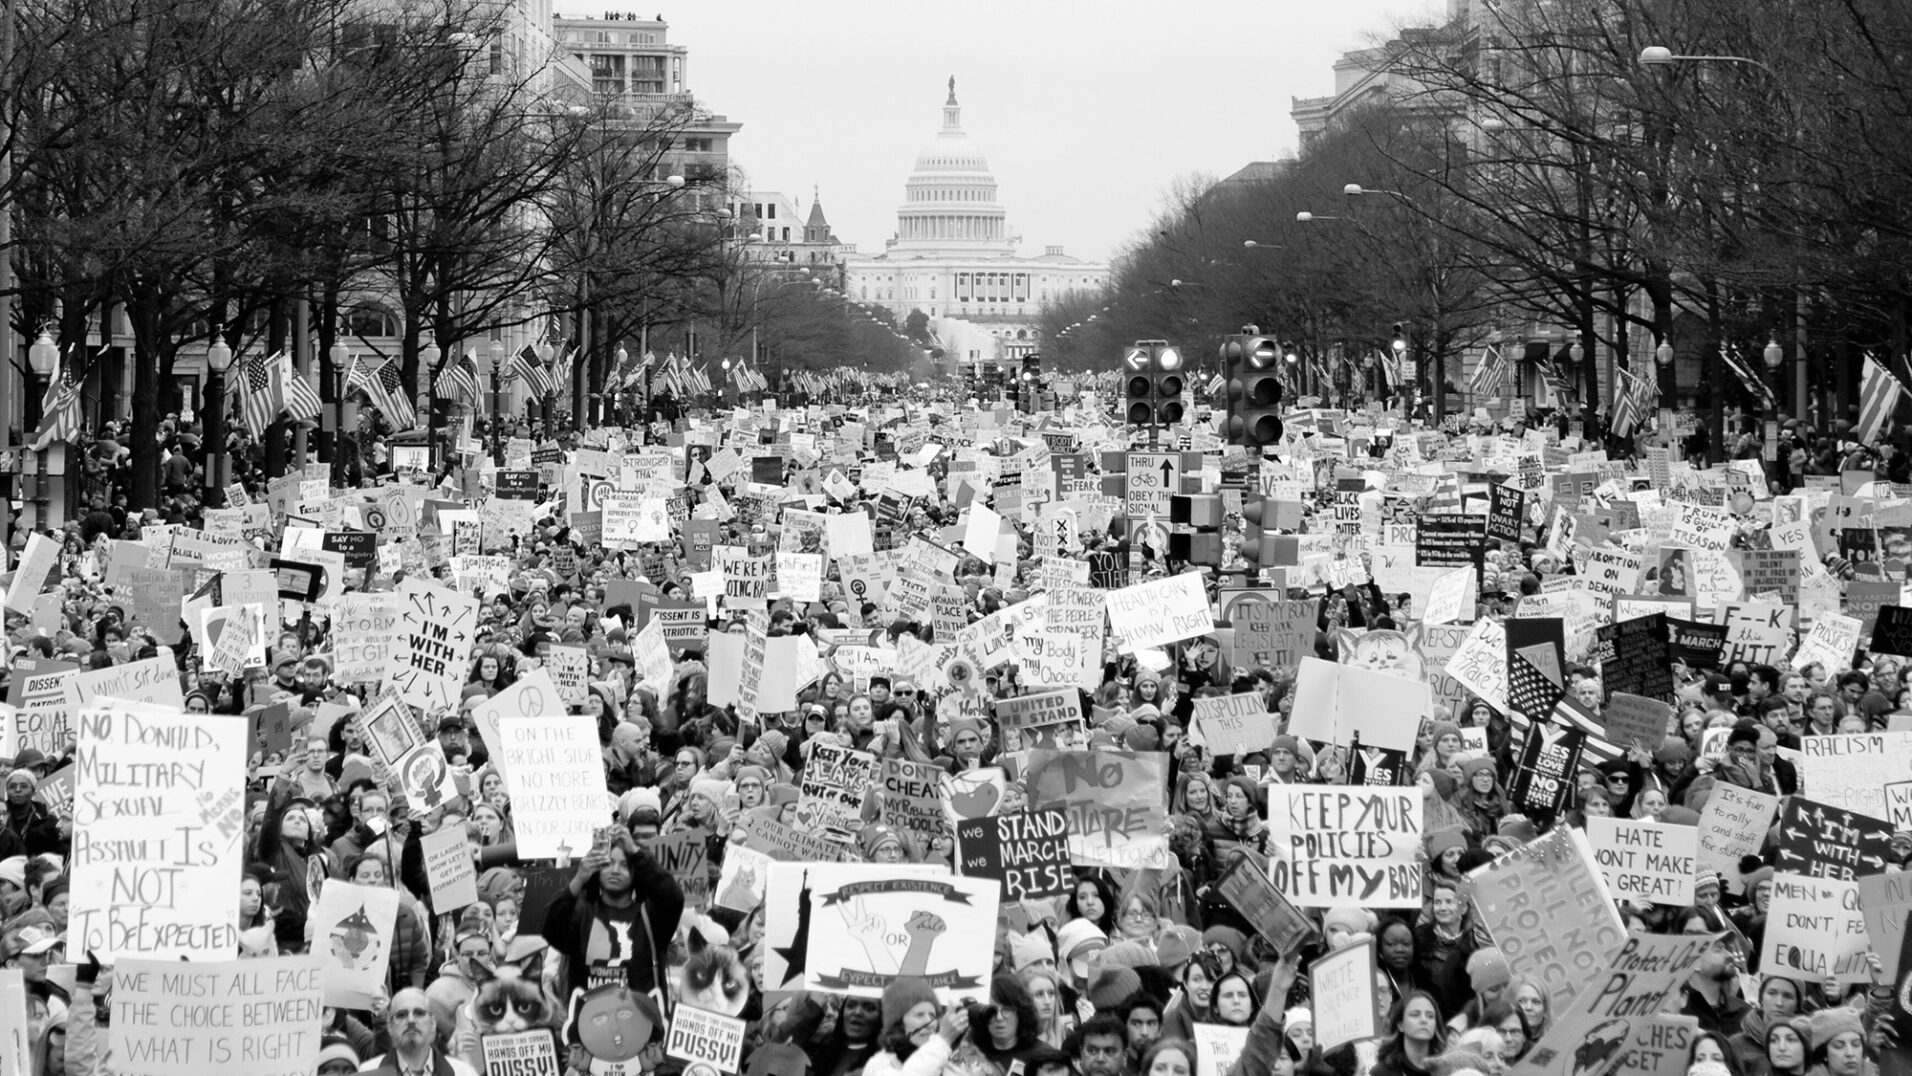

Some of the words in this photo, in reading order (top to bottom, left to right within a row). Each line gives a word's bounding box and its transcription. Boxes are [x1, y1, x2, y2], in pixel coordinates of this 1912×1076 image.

[623, 458, 669, 467] STRONGER
[1131, 457, 1154, 467] THRU
[1130, 491, 1153, 500] OBEY
[1157, 491, 1176, 500] THIS
[1334, 492, 1359, 505] BLACK
[1500, 497, 1519, 508] NOT
[1335, 507, 1360, 520] LIVES
[1491, 513, 1518, 527] OVARY
[1682, 505, 1728, 521] TRUMP
[1682, 515, 1691, 524] IS
[1694, 517, 1729, 530] GUILTY
[1335, 523, 1361, 535] MATTER
[1489, 523, 1518, 537] ACTION
[1778, 529, 1804, 545] YES
[1674, 529, 1725, 550] TREASON
[723, 560, 757, 576] WE'RE
[1589, 552, 1641, 570] ABORTION
[1603, 569, 1619, 580] ON
[1046, 589, 1066, 606] THE
[1067, 589, 1095, 606] POWER
[1588, 581, 1627, 596] DEMAND
[692, 611, 700, 620] IS
[936, 606, 961, 616] PLACE
[1046, 609, 1063, 623] THE
[1066, 610, 1094, 622] PEOPLE
[1266, 602, 1286, 620] MY
[1289, 602, 1314, 619] BODY
[337, 618, 395, 632] STORM
[421, 621, 448, 642] I'M
[935, 620, 942, 629] IS
[943, 620, 951, 630] IN
[952, 621, 966, 630] THE
[1172, 608, 1211, 635] RIGHT
[1680, 635, 1721, 648] MARCH
[1737, 627, 1764, 642] this
[409, 634, 455, 662] WITH
[1046, 641, 1076, 667] Body
[1600, 640, 1614, 651] FOR
[1600, 649, 1615, 659] OUR
[410, 652, 446, 676] HER
[562, 664, 575, 672] I'M
[558, 672, 580, 681] WITH
[560, 680, 577, 688] HER
[76, 682, 84, 703] I
[1011, 695, 1065, 713] UNITED
[1195, 694, 1266, 721] DISPUTIN
[15, 711, 72, 734] EQUAL
[1002, 713, 1023, 726] WE
[1030, 706, 1078, 724] STAND
[1218, 719, 1244, 732] THIS
[18, 731, 77, 753] RIGHTS
[515, 728, 536, 742] ON
[544, 727, 575, 741] THE
[1537, 722, 1570, 759] YES
[506, 748, 555, 765] BRIGHT
[564, 748, 594, 764] SIDE
[811, 742, 840, 763] KEEP
[840, 750, 869, 770] YOUR
[1804, 737, 1884, 756] RACISM
[78, 746, 206, 790] MILITARY
[889, 761, 943, 781] DON'T
[1359, 749, 1392, 781] YES
[1536, 756, 1565, 773] LOVE
[521, 772, 543, 788] NO
[550, 771, 591, 787] MORE
[812, 761, 868, 795] LAWS
[1530, 773, 1559, 792] NO
[40, 778, 73, 806] WE
[802, 783, 826, 798] OUT
[840, 793, 861, 809] OUR
[1719, 787, 1746, 805] It's
[1747, 793, 1766, 812] fun
[75, 791, 181, 826] SEXUAL
[199, 788, 241, 826] MEANS
[513, 795, 566, 812] GRIZZLY
[572, 794, 607, 810] BEARS
[884, 797, 901, 812] MY
[885, 812, 943, 834] SCHOOLS
[1288, 793, 1351, 831] KEEP
[1354, 793, 1418, 834] YOUR
[1713, 806, 1725, 818] to
[1726, 808, 1753, 827] rally
[519, 821, 532, 835] IN
[536, 821, 558, 834] OUR
[763, 819, 782, 835] OUR
[784, 830, 836, 854] CLIMATE
[962, 826, 984, 839] we
[998, 813, 1066, 841] STAND
[1710, 825, 1733, 839] and
[1733, 830, 1758, 845] stuff
[1820, 819, 1860, 845] I'M
[74, 829, 171, 868] ASSAULT
[174, 826, 218, 867] IS
[755, 827, 799, 850] CANNOT
[800, 847, 832, 862] WAIT
[1290, 830, 1394, 860] POLICIES
[1615, 827, 1664, 849] HATE
[1701, 837, 1720, 850] for
[428, 851, 441, 862] OK
[442, 841, 465, 857] LADIES
[655, 835, 706, 875] UNITY
[967, 856, 987, 868] we
[1000, 840, 1070, 867] MARCH
[1813, 840, 1860, 866] WITH
[430, 859, 448, 873] NOW
[448, 851, 468, 866] LET'S
[439, 868, 455, 879] GET
[452, 864, 464, 873] IN
[1646, 855, 1695, 875] MAKE
[1809, 860, 1858, 882] HER
[111, 868, 184, 908] NOT
[432, 869, 474, 894] FORMATION
[891, 879, 951, 893] EXISTENCE
[1006, 865, 1074, 895] RISE
[1274, 860, 1320, 897] OFF
[1328, 864, 1385, 900] MY
[1775, 882, 1817, 902] MEN
[1787, 914, 1834, 932] DON'T
[886, 933, 908, 947] OR
[1497, 872, 1579, 1000] PROTECT
[1611, 938, 1678, 972] Protect
[1774, 943, 1870, 976] EQUALITY
[116, 971, 149, 993] WE
[161, 973, 220, 996] MUST
[228, 971, 265, 995] ALL
[275, 967, 322, 991] FACE
[589, 967, 628, 978] WOMEN'S
[840, 970, 886, 985] EXPECT
[1587, 974, 1676, 1018] Planet
[116, 1001, 161, 1026] THE
[170, 1002, 234, 1028] CHOICE
[242, 996, 321, 1026] BETWEEN
[676, 1018, 706, 1035] HANDS
[708, 1027, 724, 1039] OFF
[727, 1032, 740, 1043] MY
[125, 1037, 196, 1065] WHAT
[208, 1039, 232, 1062] IS
[242, 1031, 307, 1061] RIGHT
[488, 1047, 517, 1058] HANDS
[519, 1045, 537, 1057] OFF
[540, 1043, 550, 1053] MY
[672, 1030, 737, 1066] PUSSY!
[1623, 1049, 1664, 1071] GET
